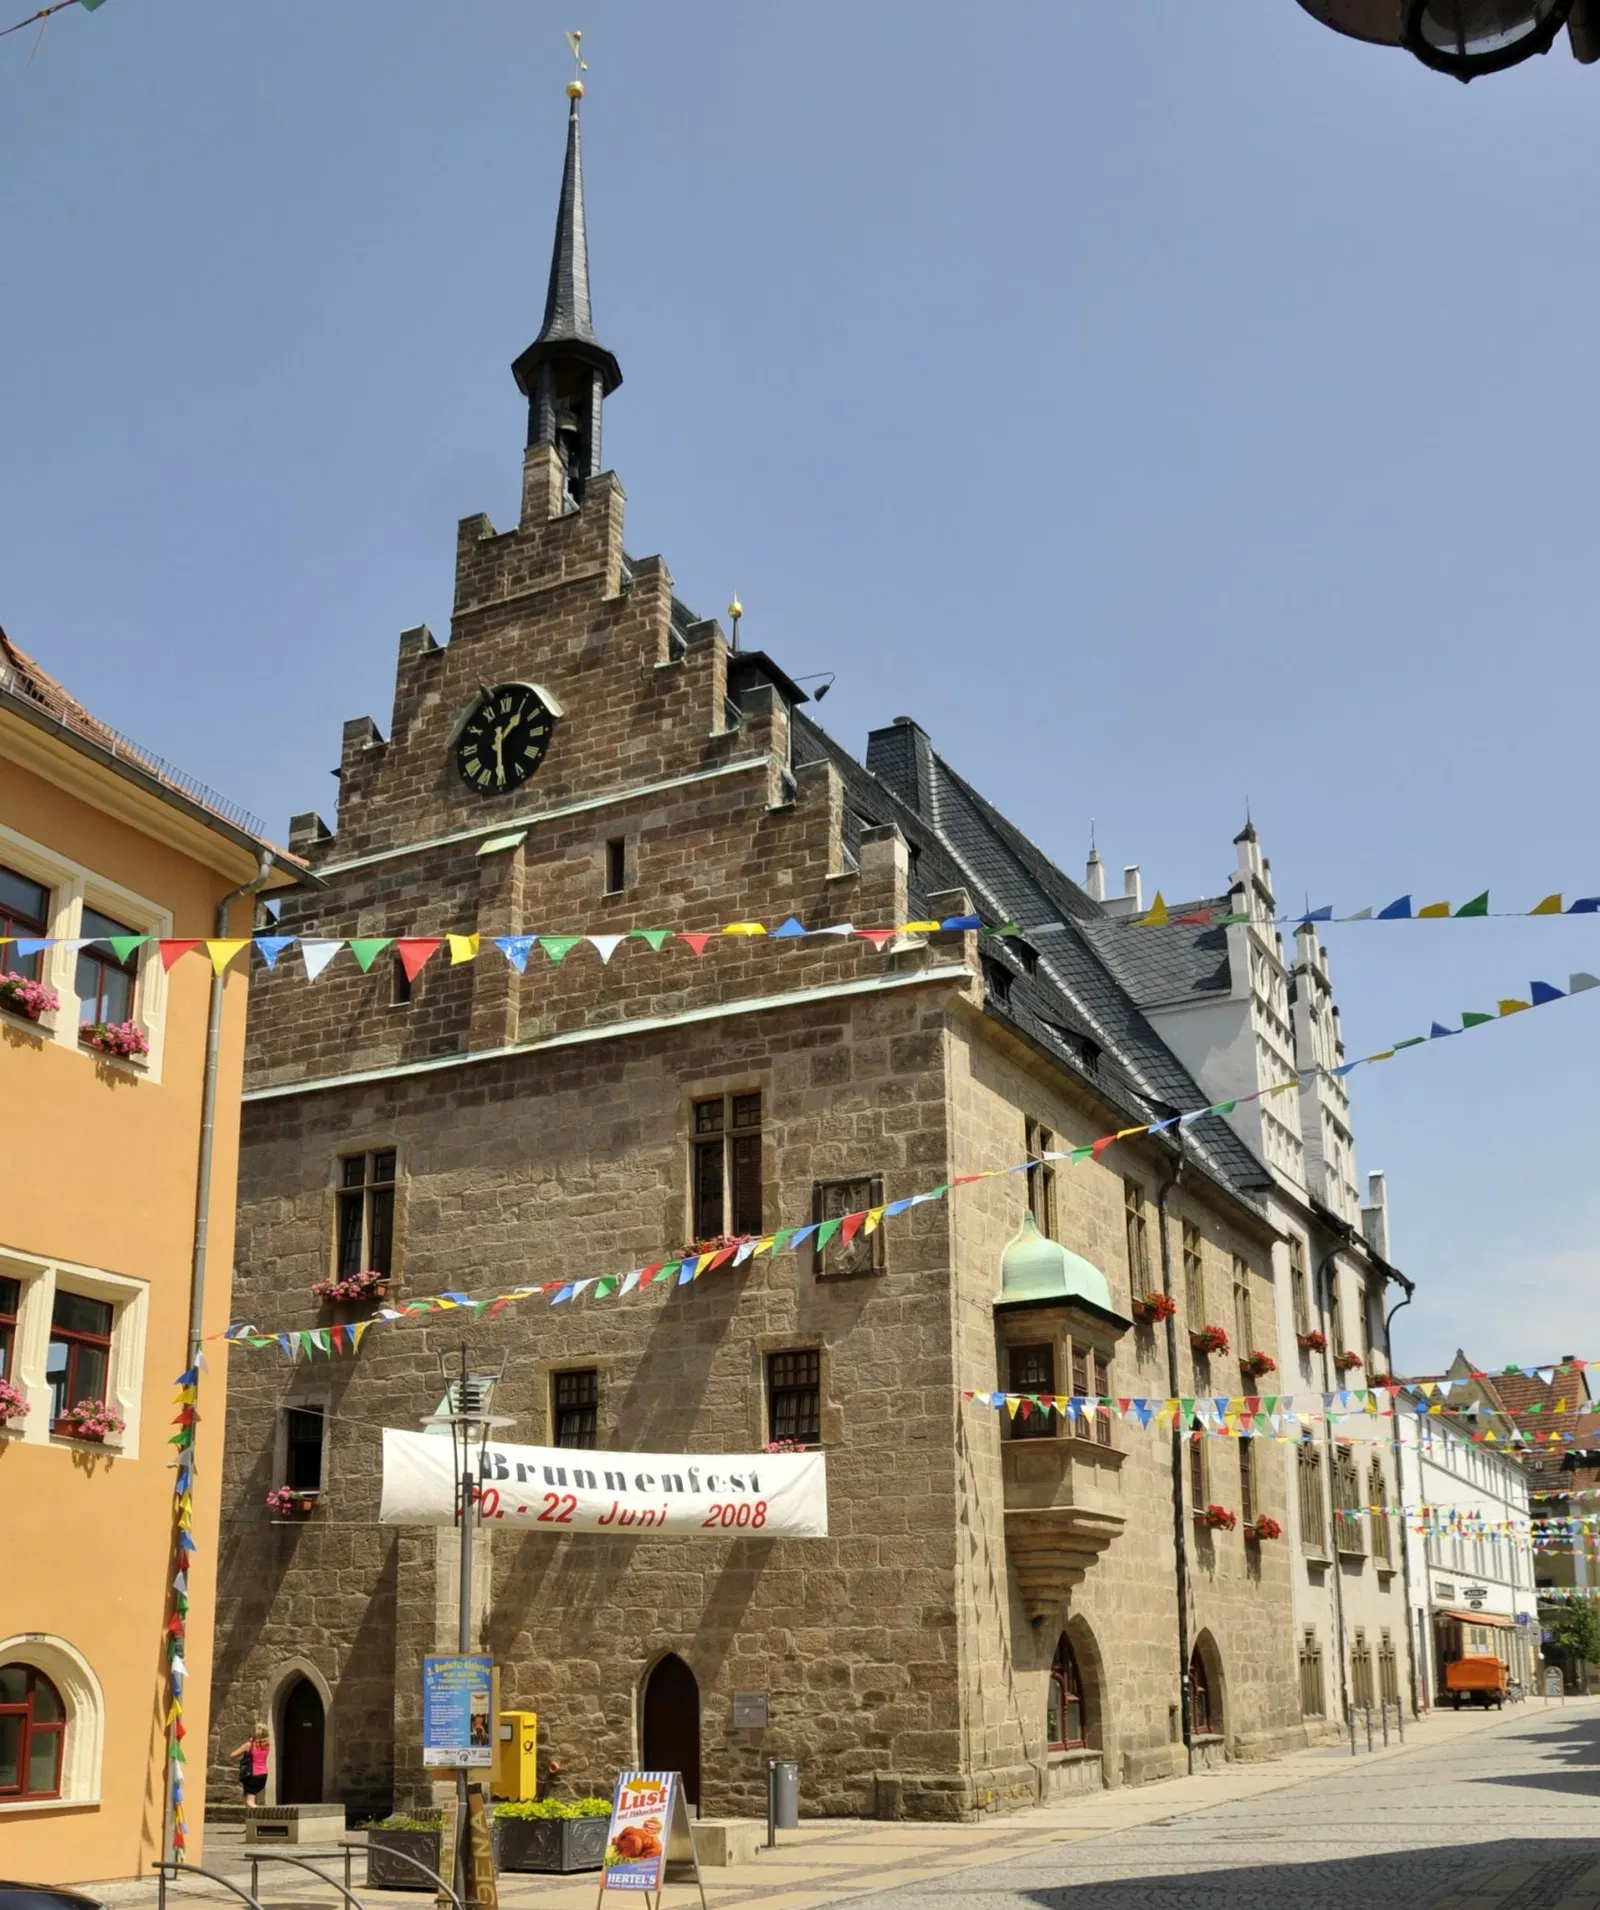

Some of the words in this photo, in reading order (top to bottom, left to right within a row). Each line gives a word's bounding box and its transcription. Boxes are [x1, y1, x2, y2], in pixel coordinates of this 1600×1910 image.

[476, 1451, 762, 1494] Brunnenfest
[537, 1491, 578, 1524] 22
[597, 1500, 669, 1528] Juni
[702, 1500, 768, 1529] 2008
[619, 1786, 668, 1811] Lust
[607, 1873, 656, 1885] HERTEL'S
